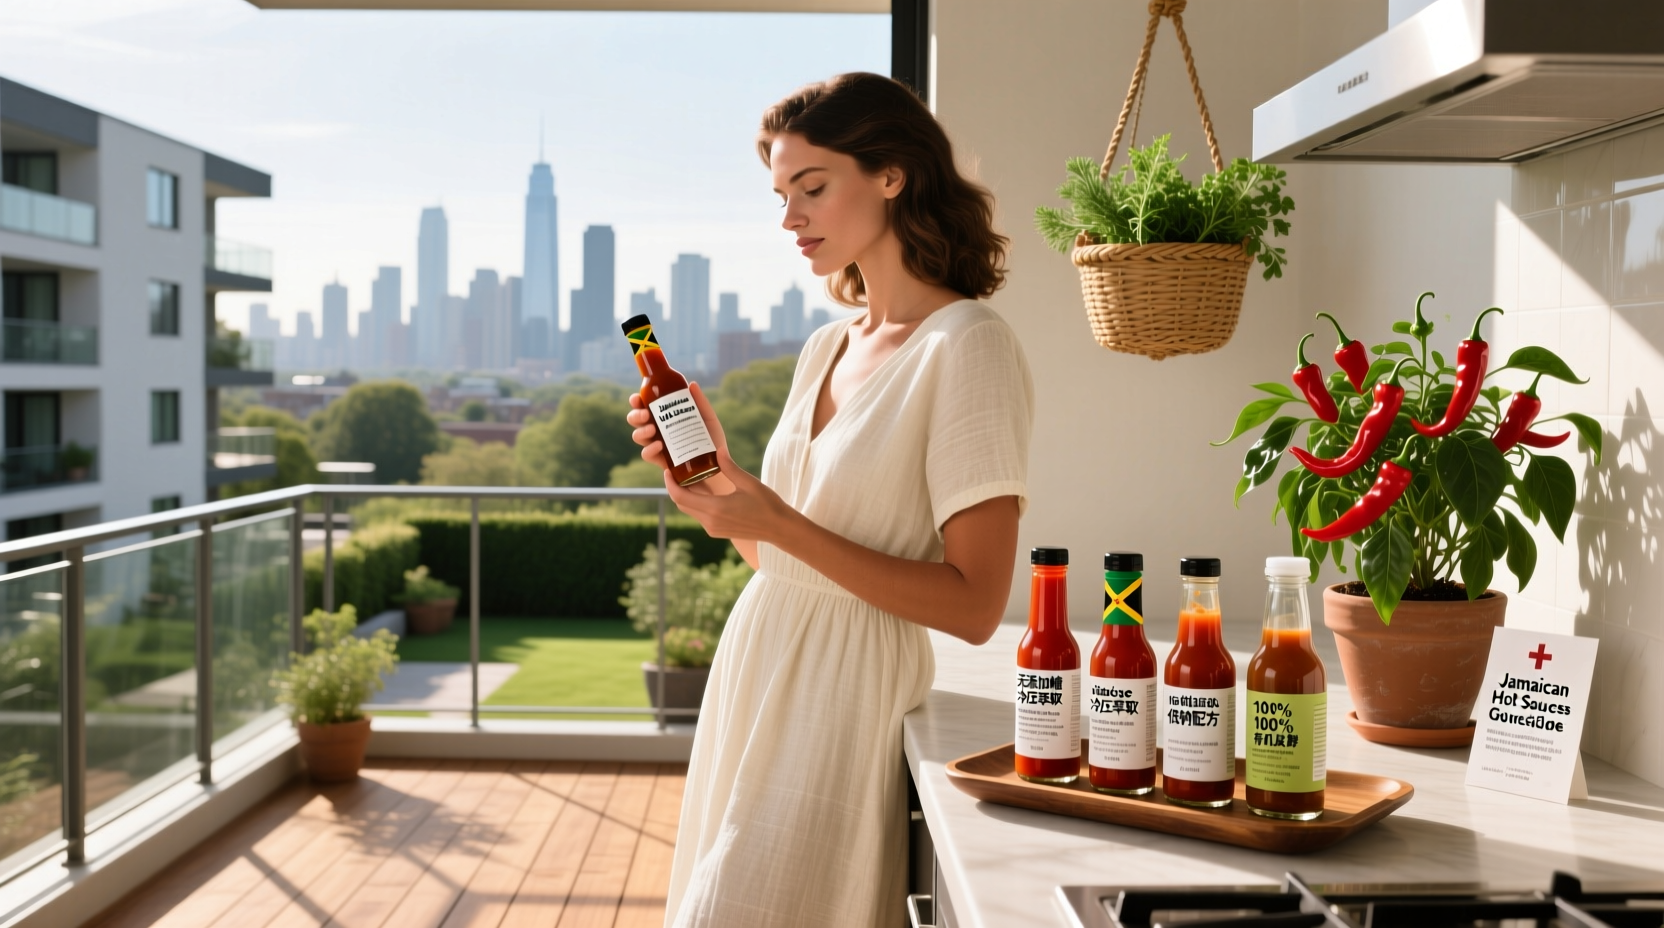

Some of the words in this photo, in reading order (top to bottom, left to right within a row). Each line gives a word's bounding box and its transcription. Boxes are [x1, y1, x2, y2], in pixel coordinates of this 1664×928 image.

[1498, 673, 1569, 697] Jamaican
[1492, 690, 1517, 706] Hot
[1253, 700, 1292, 717] 100%
[1254, 716, 1294, 733] 100%
